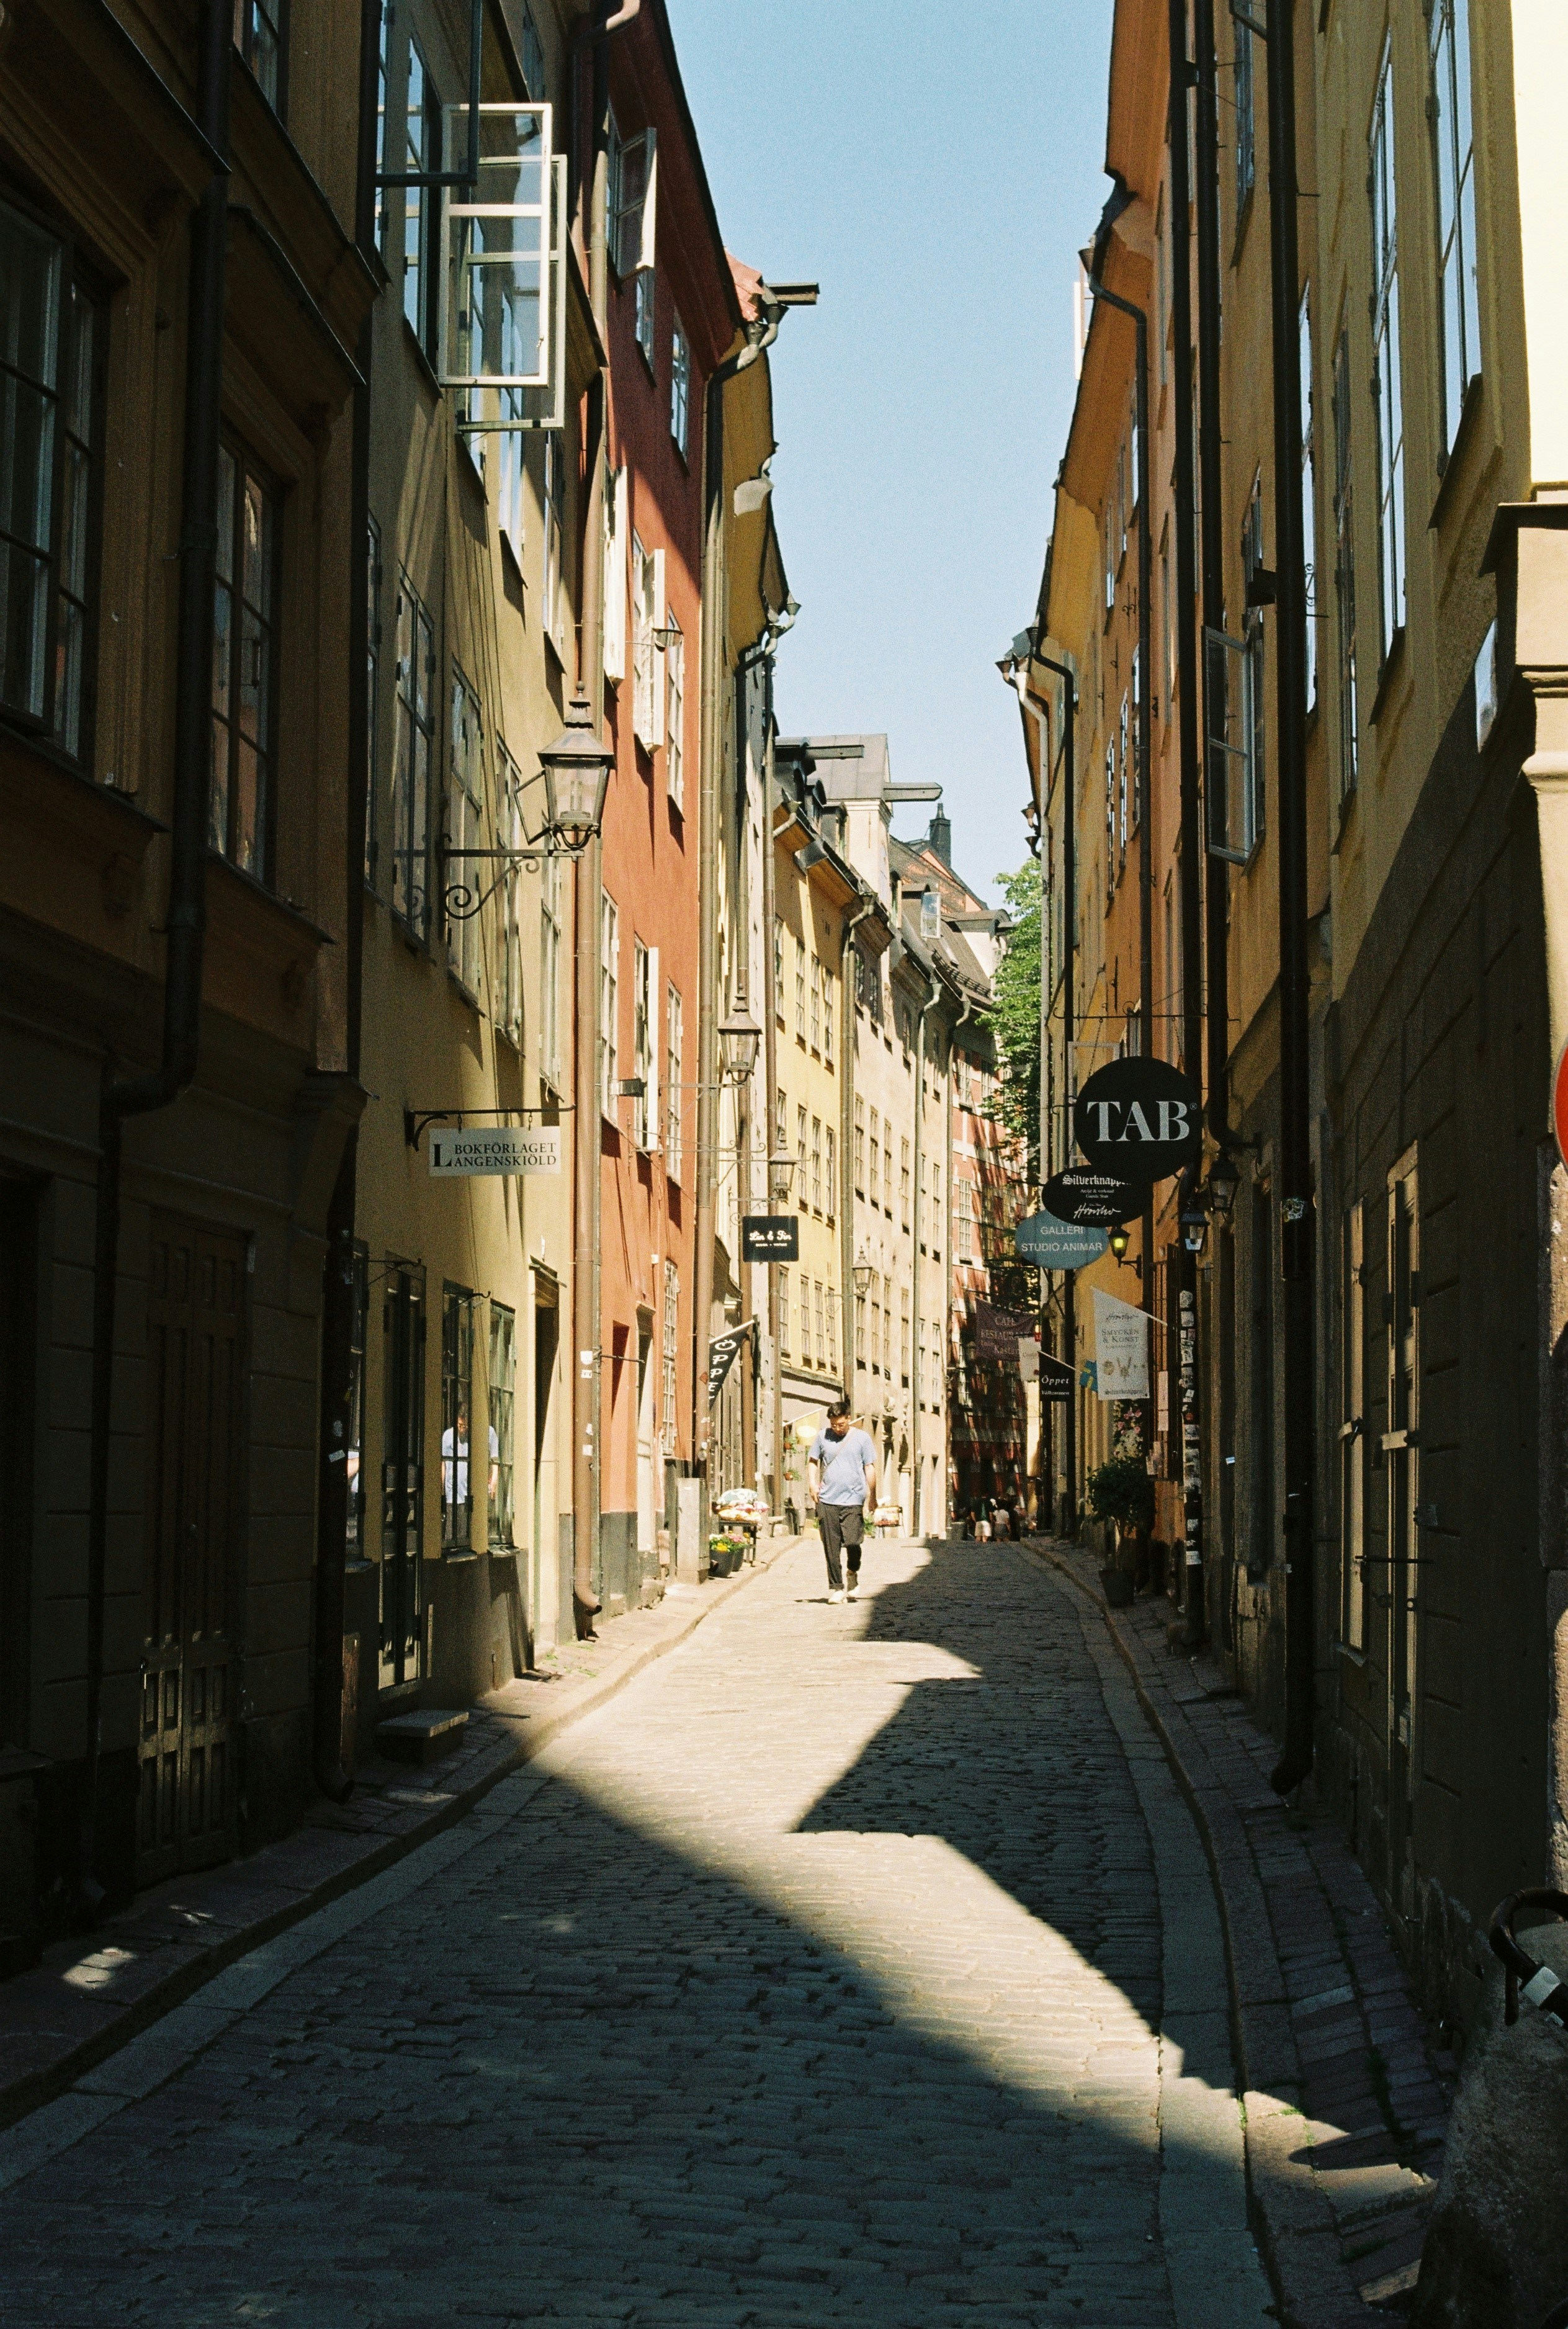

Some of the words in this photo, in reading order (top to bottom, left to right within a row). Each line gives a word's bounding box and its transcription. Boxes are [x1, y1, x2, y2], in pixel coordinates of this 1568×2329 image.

[1086, 1101, 1190, 1142] TAB
[454, 1142, 557, 1154] BOKFÖRLAGET
[1041, 1226, 1083, 1235] GALLERI
[767, 1231, 774, 1241] &
[1021, 1242, 1060, 1252] STUDIO
[1063, 1242, 1103, 1251] ANIMAR
[1041, 1375, 1069, 1385] Öppet
